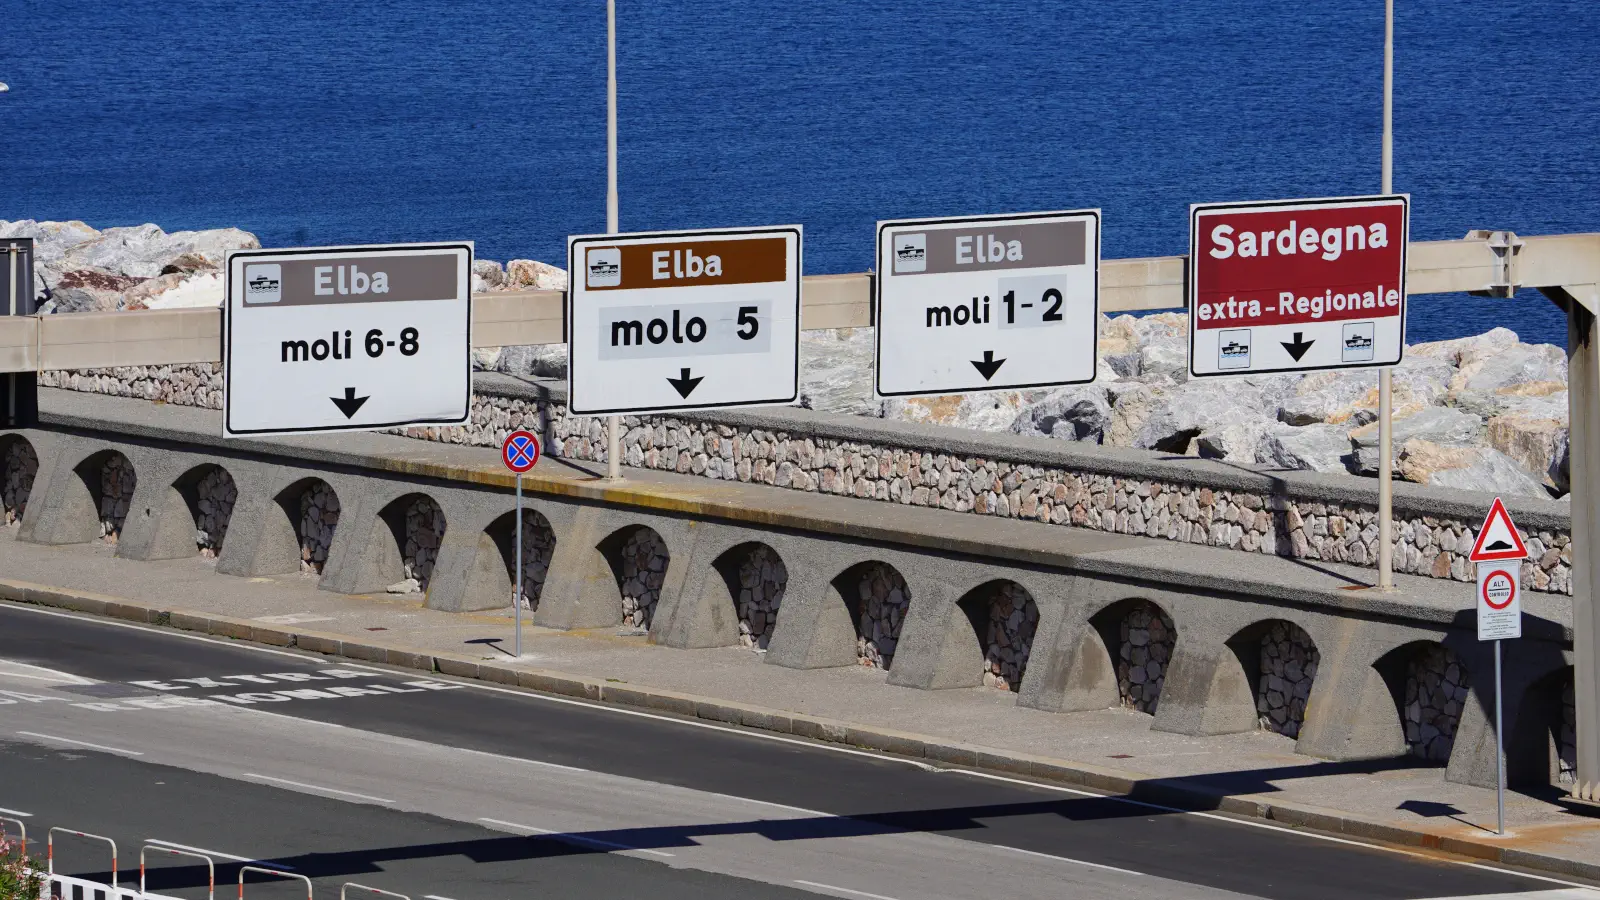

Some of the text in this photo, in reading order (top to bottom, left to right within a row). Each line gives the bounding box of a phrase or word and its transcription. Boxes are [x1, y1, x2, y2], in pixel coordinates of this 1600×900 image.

[955, 234, 1024, 265] Elba
[1209, 219, 1389, 262] Sardegna
[314, 264, 390, 296] Elba
[652, 249, 723, 280] Elba
[611, 306, 759, 347] molo 5
[926, 295, 990, 328] moli
[281, 326, 420, 363] moli 6-8
[127, 669, 382, 690] EXTRA
[69, 680, 465, 712] REGIONALE
